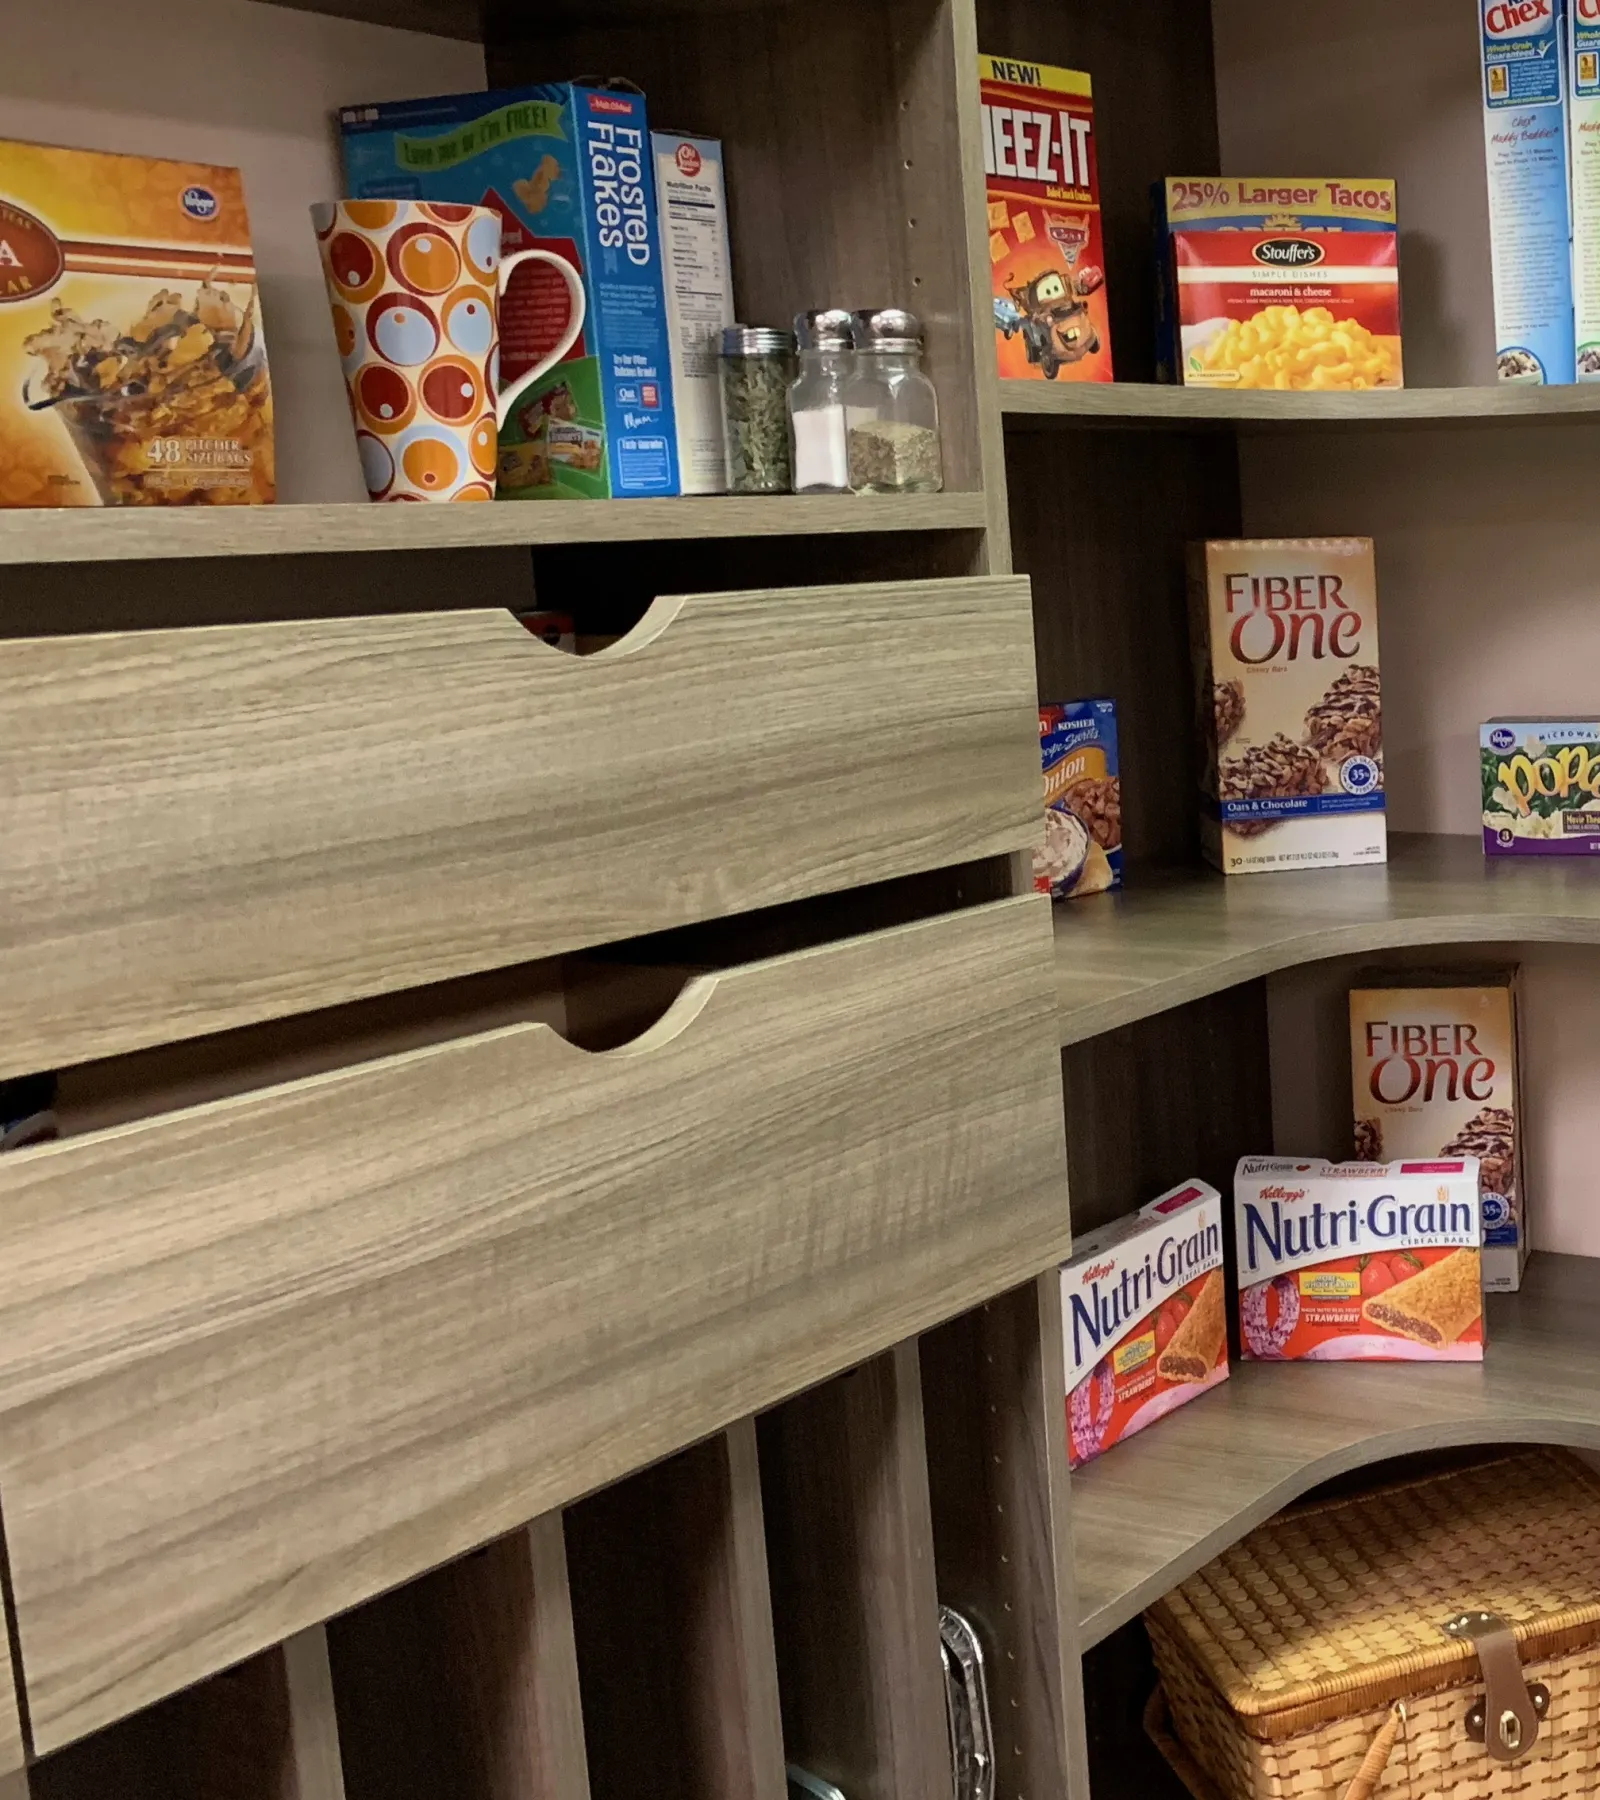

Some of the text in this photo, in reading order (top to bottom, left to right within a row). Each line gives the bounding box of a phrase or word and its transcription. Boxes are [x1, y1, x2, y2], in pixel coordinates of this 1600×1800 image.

[1486, 0, 1549, 33] Chex
[992, 60, 1041, 87] NEW!
[667, 181, 712, 193] Nutrition Facts
[1172, 183, 1392, 212] 25% Larger Tacos
[1262, 244, 1316, 262] Stouffer's
[1250, 286, 1332, 297] macaroni & cheese
[147, 439, 240, 463] 48 PITCHER
[214, 452, 251, 463] BAGS
[1223, 573, 1350, 613] FIBER
[1229, 611, 1362, 664] One
[1058, 719, 1095, 732] KOSHER
[1227, 803, 1250, 813] Oats
[1261, 799, 1309, 811] Chocolate
[1567, 815, 1584, 824] Movie
[1230, 857, 1243, 867] 30
[1366, 1021, 1482, 1057] FIBER
[1369, 1055, 1496, 1104] One
[1320, 1167, 1391, 1175] STRAWBERRY
[1259, 1185, 1308, 1202] Kellogg's
[1401, 1236, 1470, 1246] CEREAL BARS
[1081, 1258, 1116, 1285] Kellogg's
[1202, 1258, 1219, 1271] BARS
[1305, 1313, 1360, 1323] STRAWBERRY
[1117, 1372, 1156, 1402] STRAWBERRY
